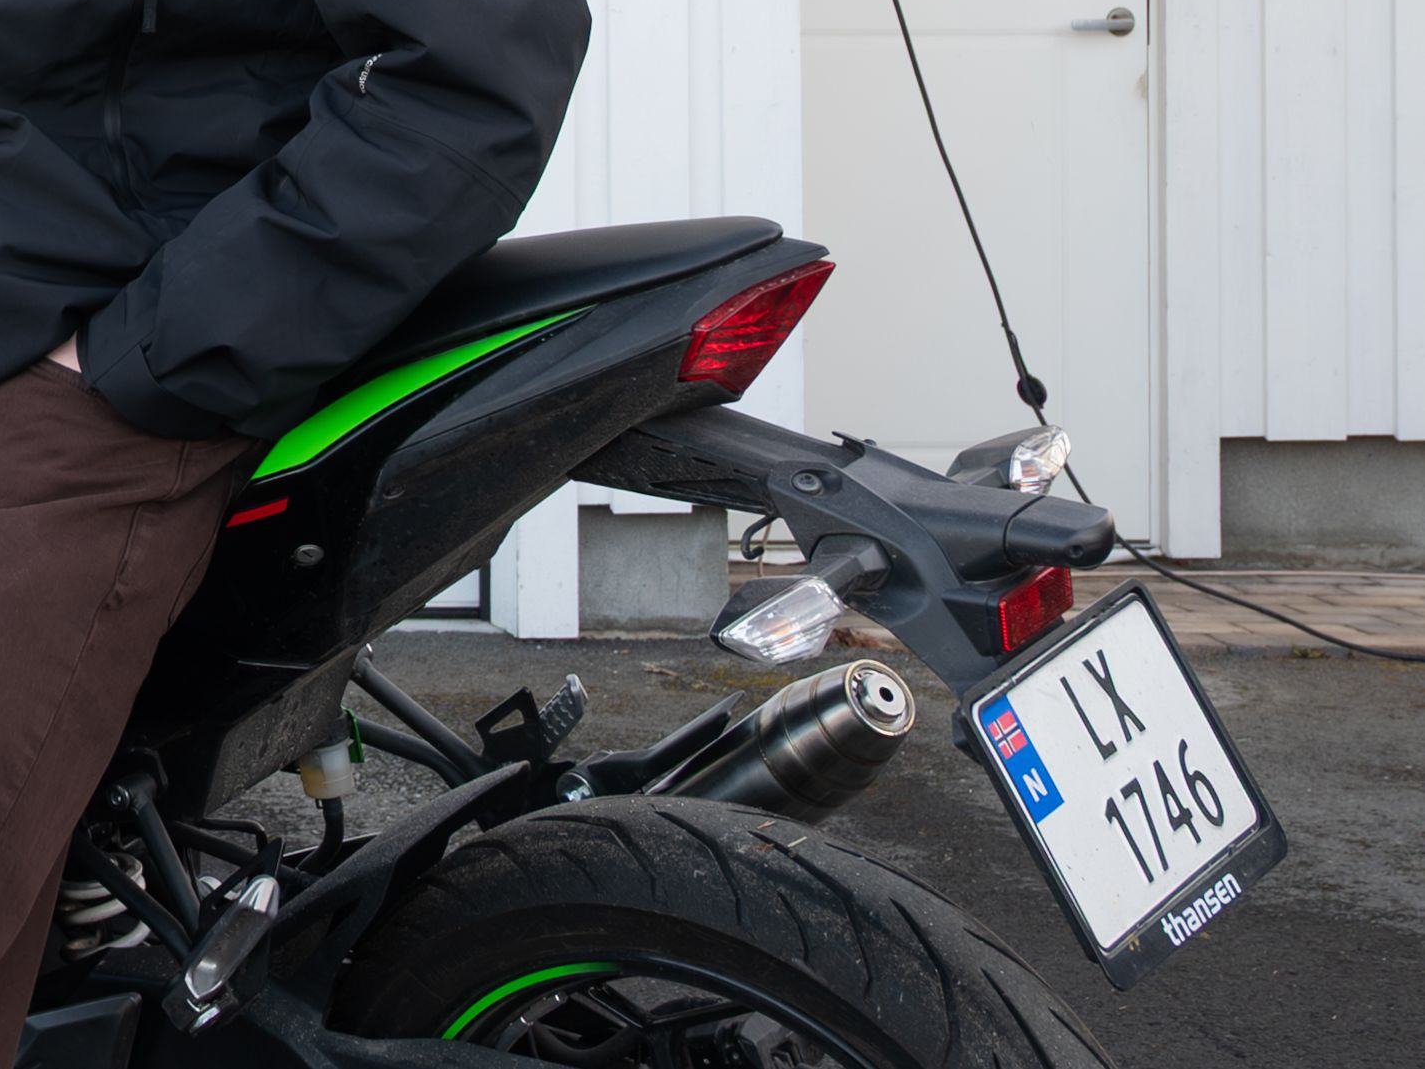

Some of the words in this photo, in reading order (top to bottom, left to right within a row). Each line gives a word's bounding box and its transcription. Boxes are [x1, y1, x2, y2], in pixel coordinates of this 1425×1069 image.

[1060, 649, 1146, 760] LX
[1023, 768, 1048, 802] N
[1105, 738, 1224, 883] 1746
[1160, 873, 1242, 946] thansen
